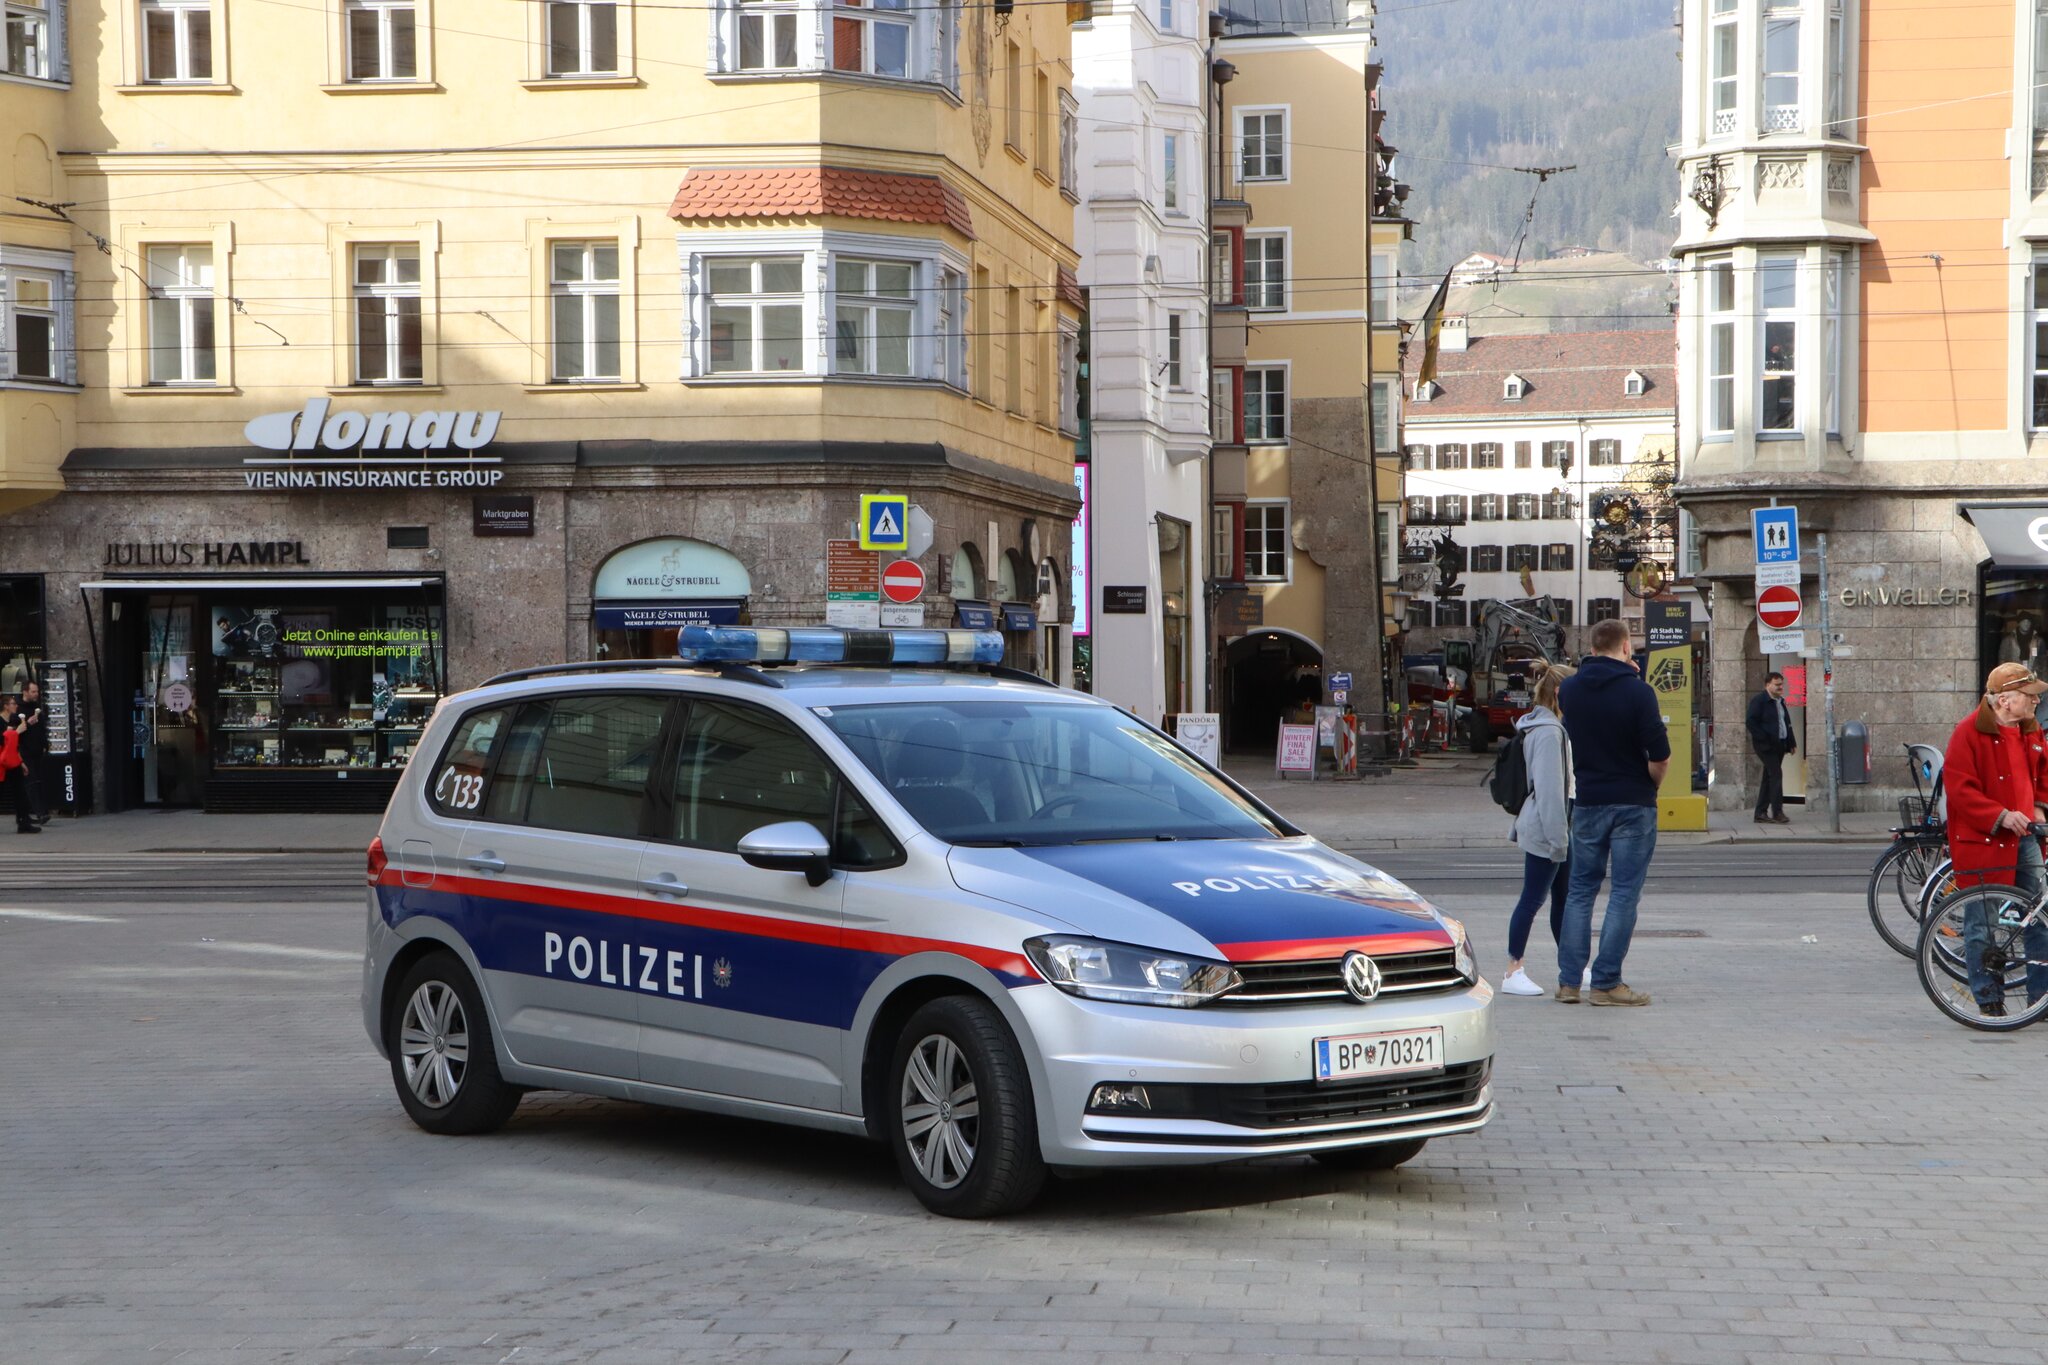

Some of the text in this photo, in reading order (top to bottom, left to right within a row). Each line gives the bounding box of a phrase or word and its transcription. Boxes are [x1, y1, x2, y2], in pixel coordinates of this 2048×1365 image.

[244, 397, 502, 450] donau
[244, 470, 503, 488] VIENNA INSURANCE GROUP
[482, 509, 529, 520] Marktgraben
[103, 541, 310, 566] JULIUS HAMPL
[661, 574, 675, 588] &
[676, 577, 721, 585] STRUBELL
[624, 610, 710, 620] NÄGELE & STRUBELL
[386, 617, 441, 629] TISSO
[282, 629, 440, 642] Jetzt Online einkaufen be
[1762, 633, 1802, 641] ausgenommen
[303, 645, 422, 660] www.juliushampl.at
[1284, 734, 1311, 742] WINTER
[1287, 748, 1304, 756] SALE
[64, 765, 74, 801] CASIO
[450, 773, 484, 809] 133
[545, 931, 703, 998] POLIZEI
[1339, 1036, 1433, 1071] BP 70321
[1322, 1064, 1328, 1073] A
